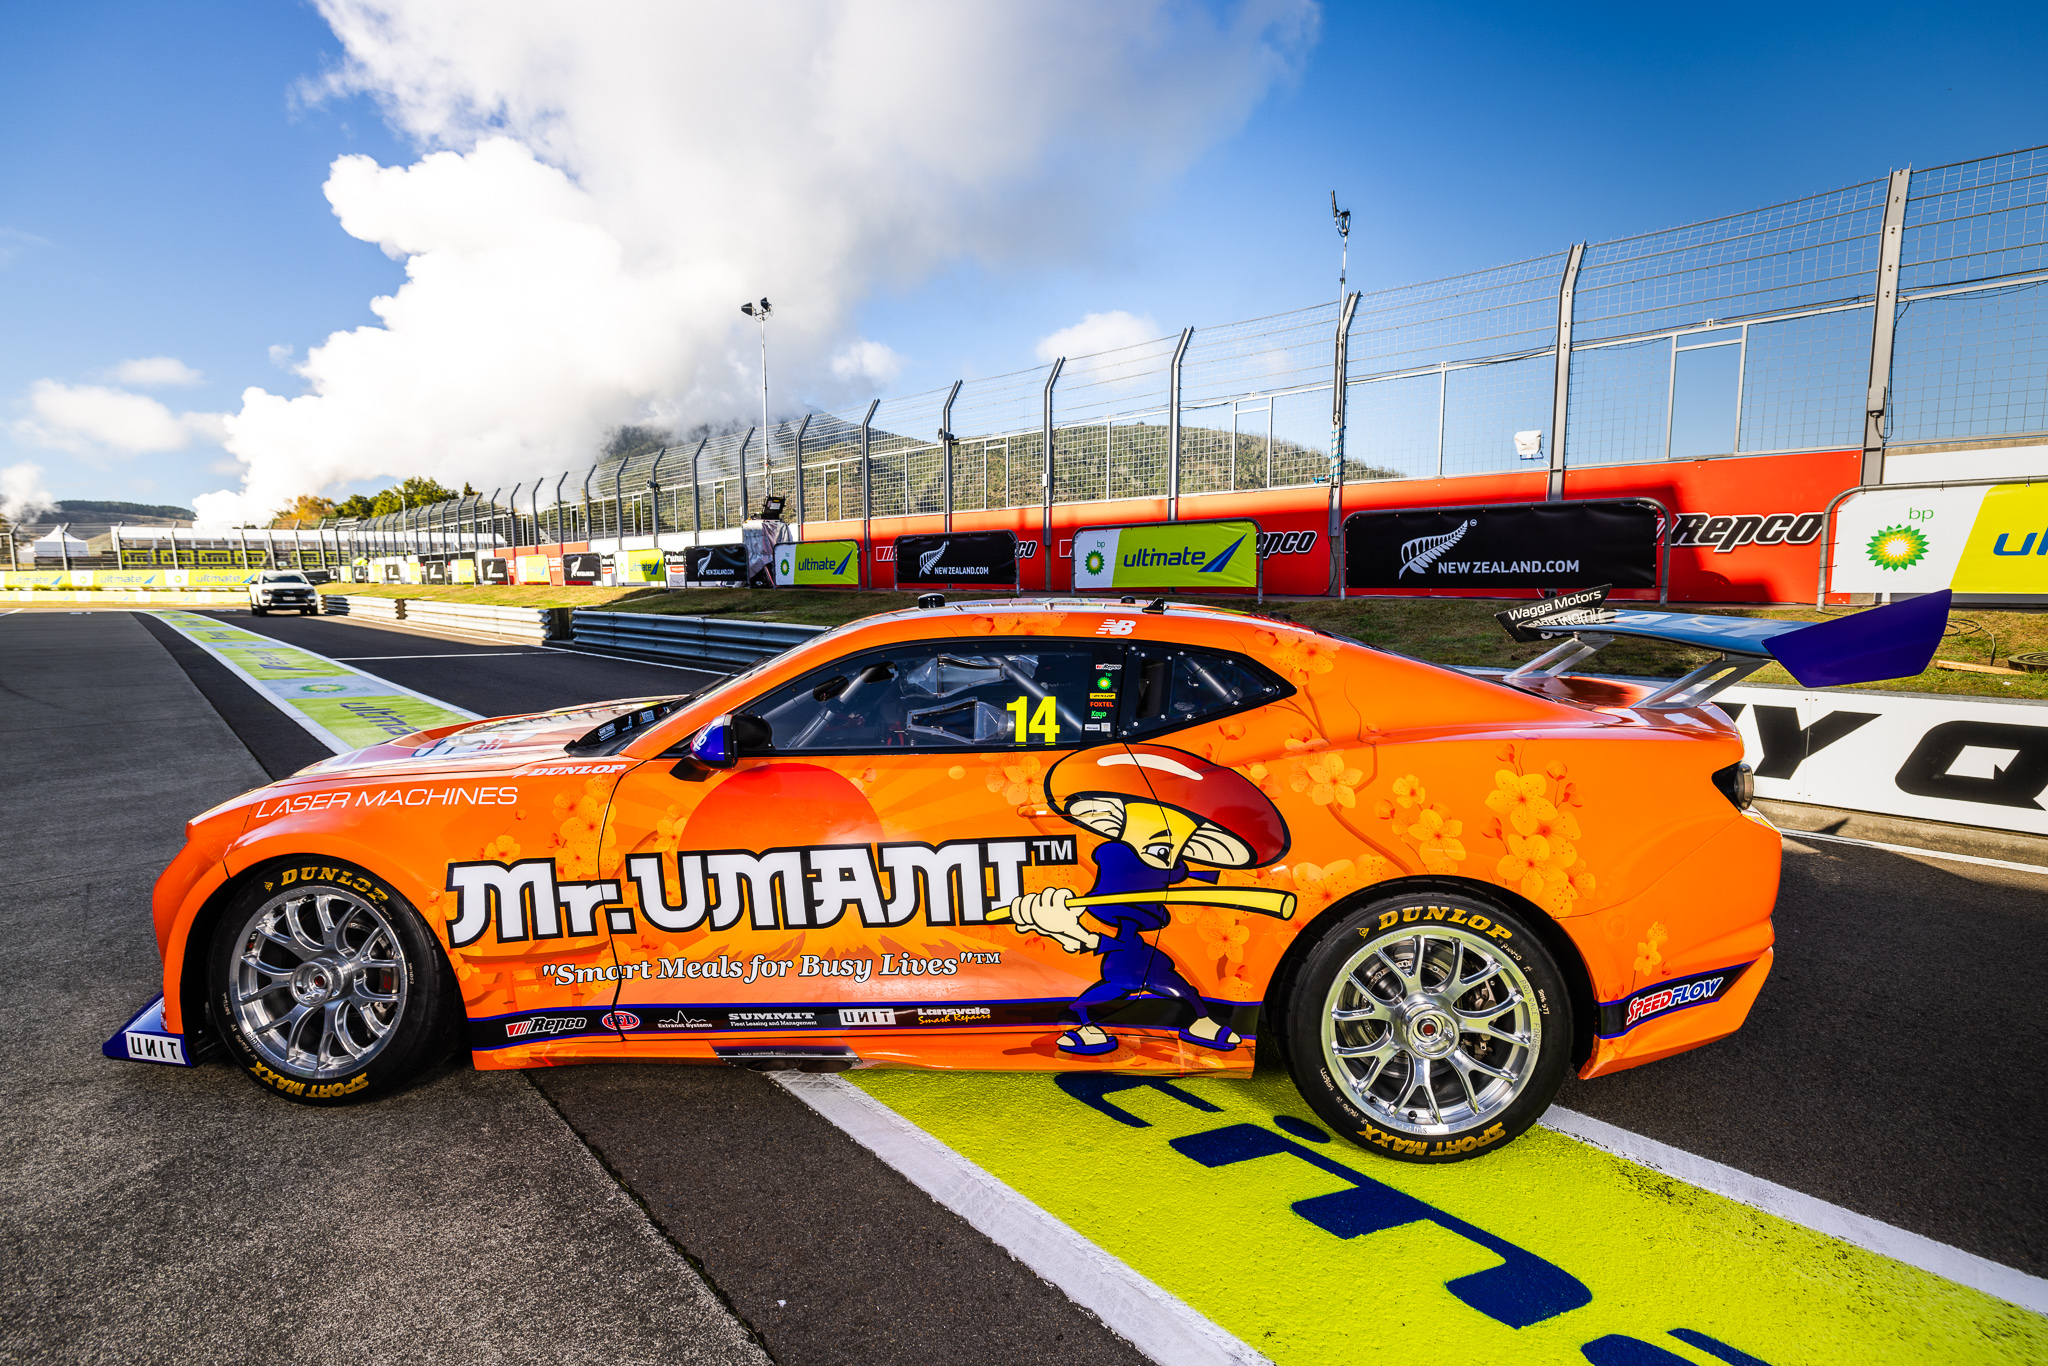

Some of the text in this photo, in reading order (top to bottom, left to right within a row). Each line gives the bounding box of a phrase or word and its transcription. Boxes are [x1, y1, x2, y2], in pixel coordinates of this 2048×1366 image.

[1908, 507, 1934, 521] bp
[1096, 540, 1106, 548] bp
[1671, 513, 1826, 553] Repco
[798, 557, 836, 571] ultimate
[1123, 546, 1206, 568] ultimate
[1438, 560, 1580, 574] NEW ZEALAND.COM
[934, 566, 989, 575] NEW ZEALAND.COM
[1508, 603, 1553, 620] Wagga
[1555, 590, 1602, 610] Motors
[1006, 696, 1061, 746] 14
[1091, 710, 1107, 719] Kayo
[528, 764, 627, 778] DUNLOP
[255, 786, 519, 819] LASER MACHINES
[281, 867, 389, 902] DUNLOP
[1378, 906, 1513, 940] DUNLOP
[542, 961, 652, 986] "Smart
[656, 955, 743, 979] Meals
[743, 954, 794, 984] for
[798, 954, 873, 983] Busy
[917, 1007, 990, 1016] Lansvale
[1626, 977, 1724, 1025] SPEEDFLOW
[527, 1017, 588, 1034] Repco
[606, 1014, 637, 1026] PFD
[728, 1012, 816, 1021] SUMMIT
[918, 1013, 992, 1024] Smash Repairs
[1520, 977, 1541, 1054] PRO RACE FORGED
[249, 1061, 306, 1096] MAXX
[306, 1072, 369, 1098] SPORT
[1357, 1122, 1506, 1156] SPORT MAXX
